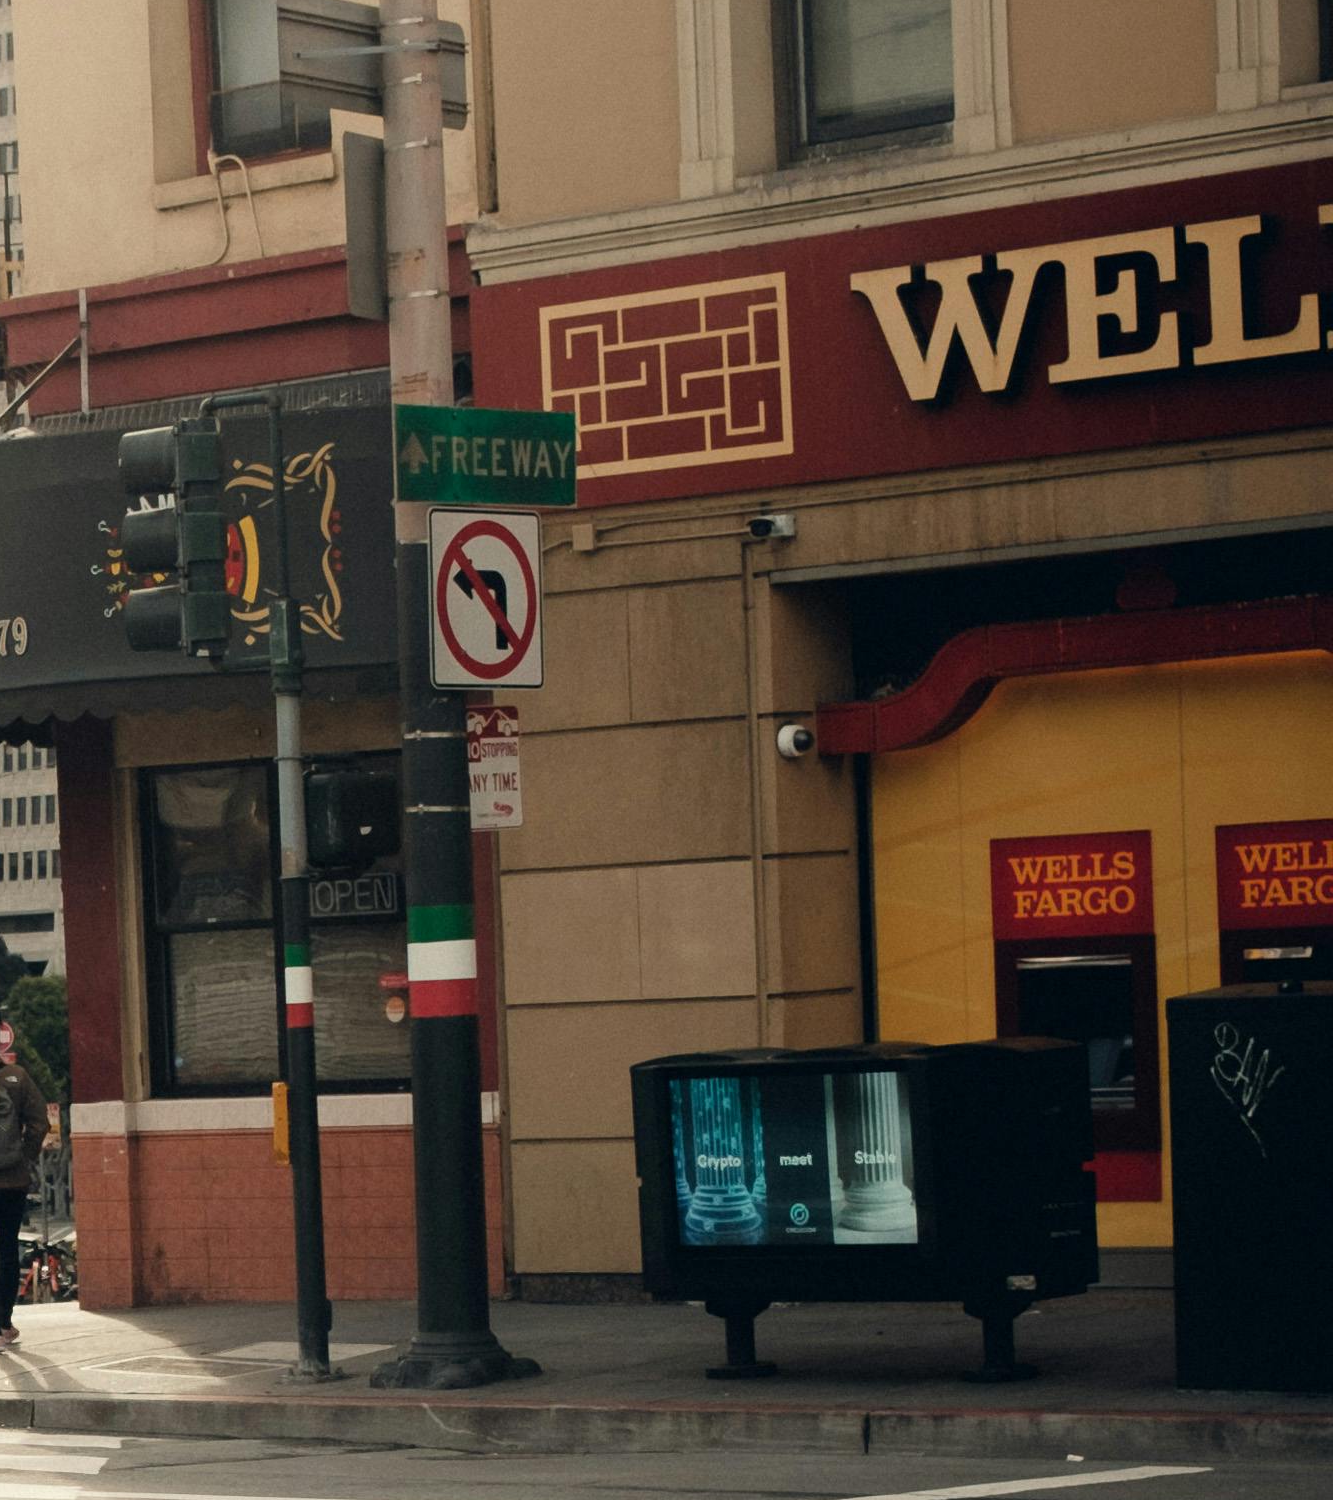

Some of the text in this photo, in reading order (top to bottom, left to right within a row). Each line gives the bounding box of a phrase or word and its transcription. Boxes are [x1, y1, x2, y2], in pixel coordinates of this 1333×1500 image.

[850, 204, 1333, 401] WEL
[431, 435, 572, 479] FREEWAY
[492, 772, 518, 791] TIME
[1008, 851, 1136, 885] WELLS
[314, 877, 393, 914] OPEN
[1013, 885, 1136, 918] FARGO
[697, 1150, 896, 1171] Crypto meet Stable
